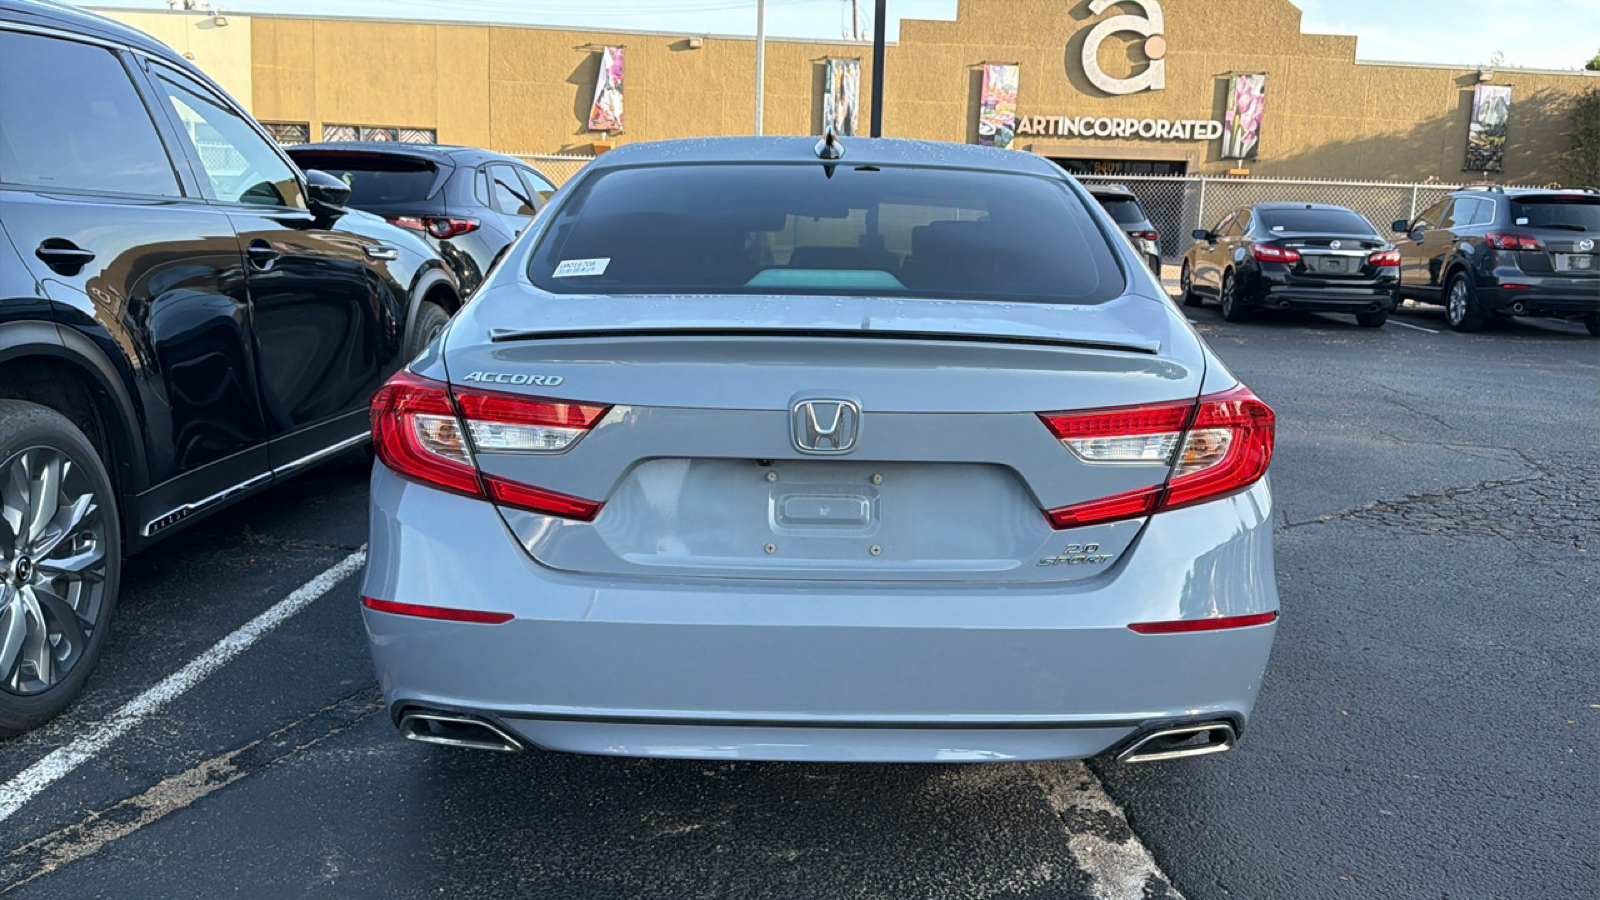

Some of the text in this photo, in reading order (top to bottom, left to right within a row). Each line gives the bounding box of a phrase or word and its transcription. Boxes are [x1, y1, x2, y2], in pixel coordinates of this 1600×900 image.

[1017, 115, 1223, 140] ARTINCORPORATED
[1094, 161, 1120, 172] 9401
[463, 370, 564, 386] ACCORD
[1064, 543, 1100, 554] 2.0
[1036, 554, 1115, 566] SPORT
